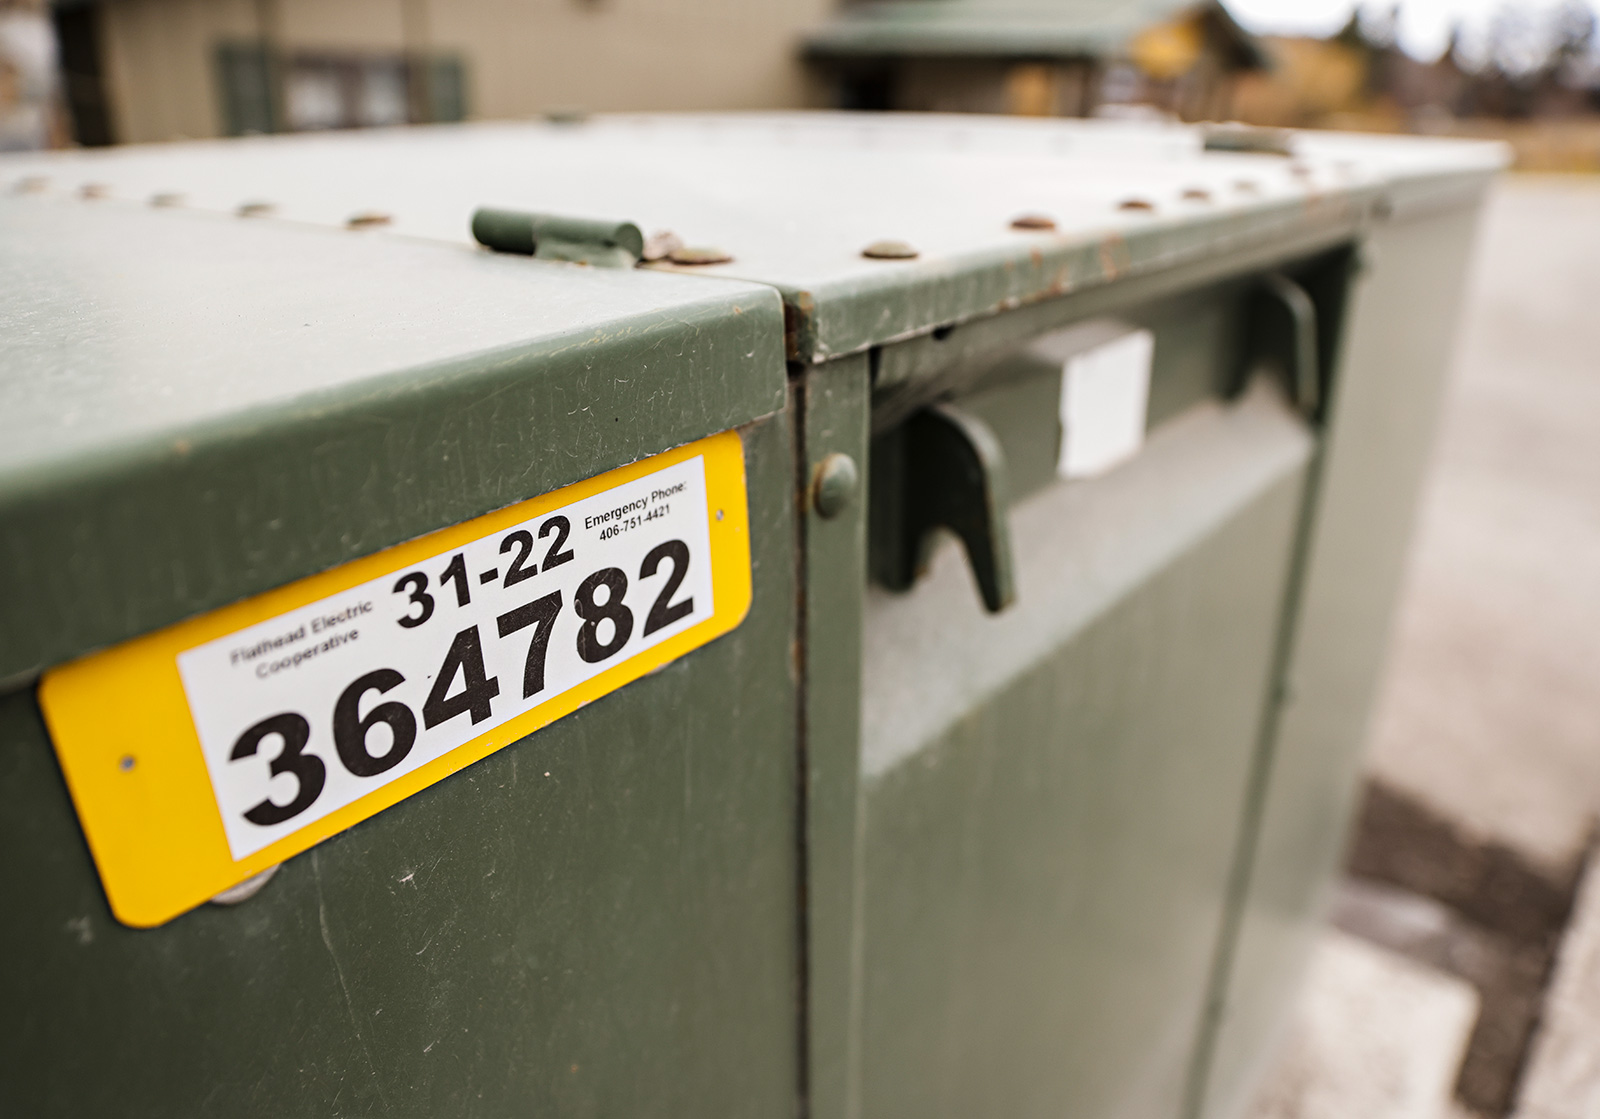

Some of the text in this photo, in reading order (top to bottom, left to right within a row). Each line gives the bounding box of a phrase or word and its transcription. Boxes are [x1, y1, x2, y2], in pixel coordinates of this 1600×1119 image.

[584, 481, 688, 530] Emergency Phone:
[599, 503, 671, 541] 406-751-4421
[392, 515, 575, 629] 31-22
[229, 600, 374, 666] Flathead Electric
[255, 629, 360, 679] Cooperative
[228, 539, 694, 827] 364782
